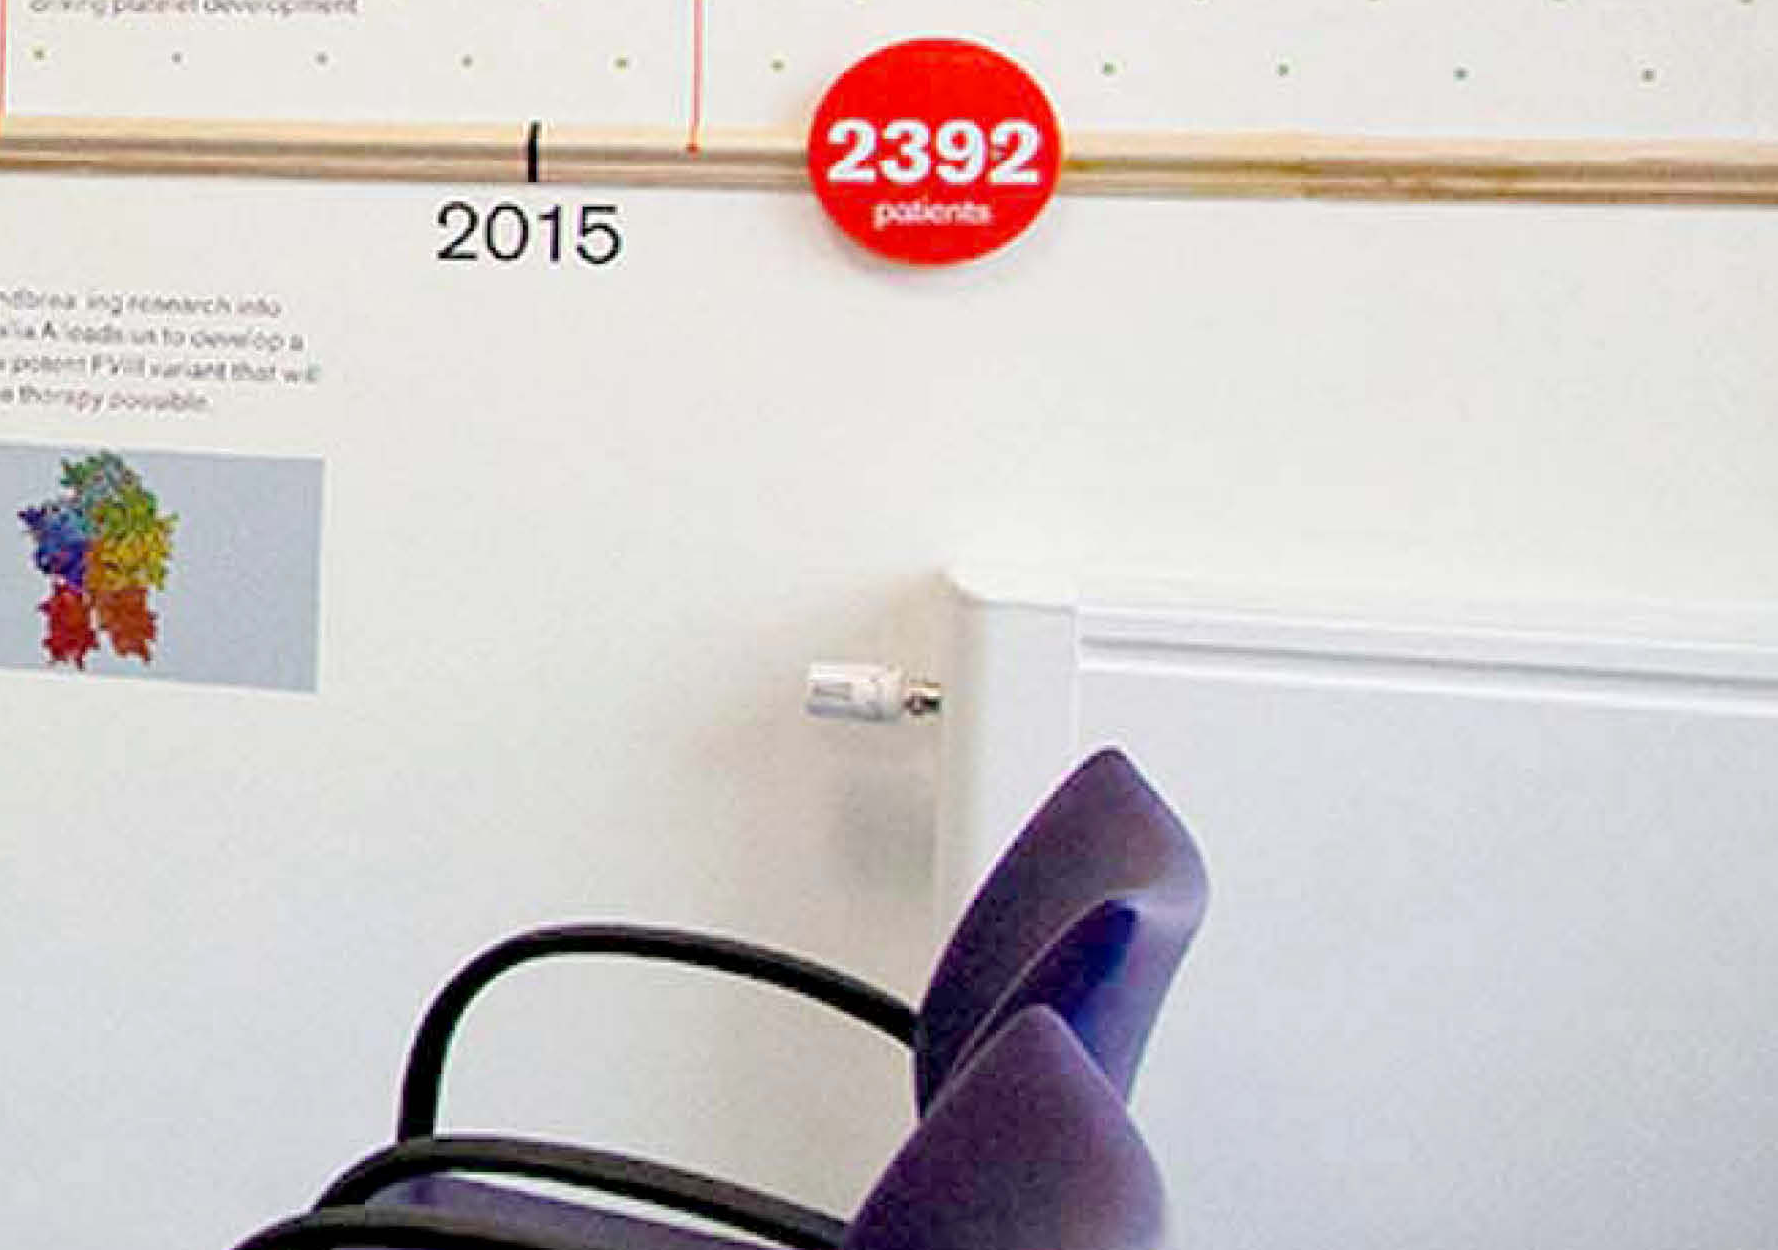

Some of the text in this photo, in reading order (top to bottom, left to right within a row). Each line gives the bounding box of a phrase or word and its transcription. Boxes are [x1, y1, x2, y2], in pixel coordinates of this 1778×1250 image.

[826, 118, 1041, 184] 2392
[436, 200, 622, 266] 2015
[872, 199, 993, 230] patients
